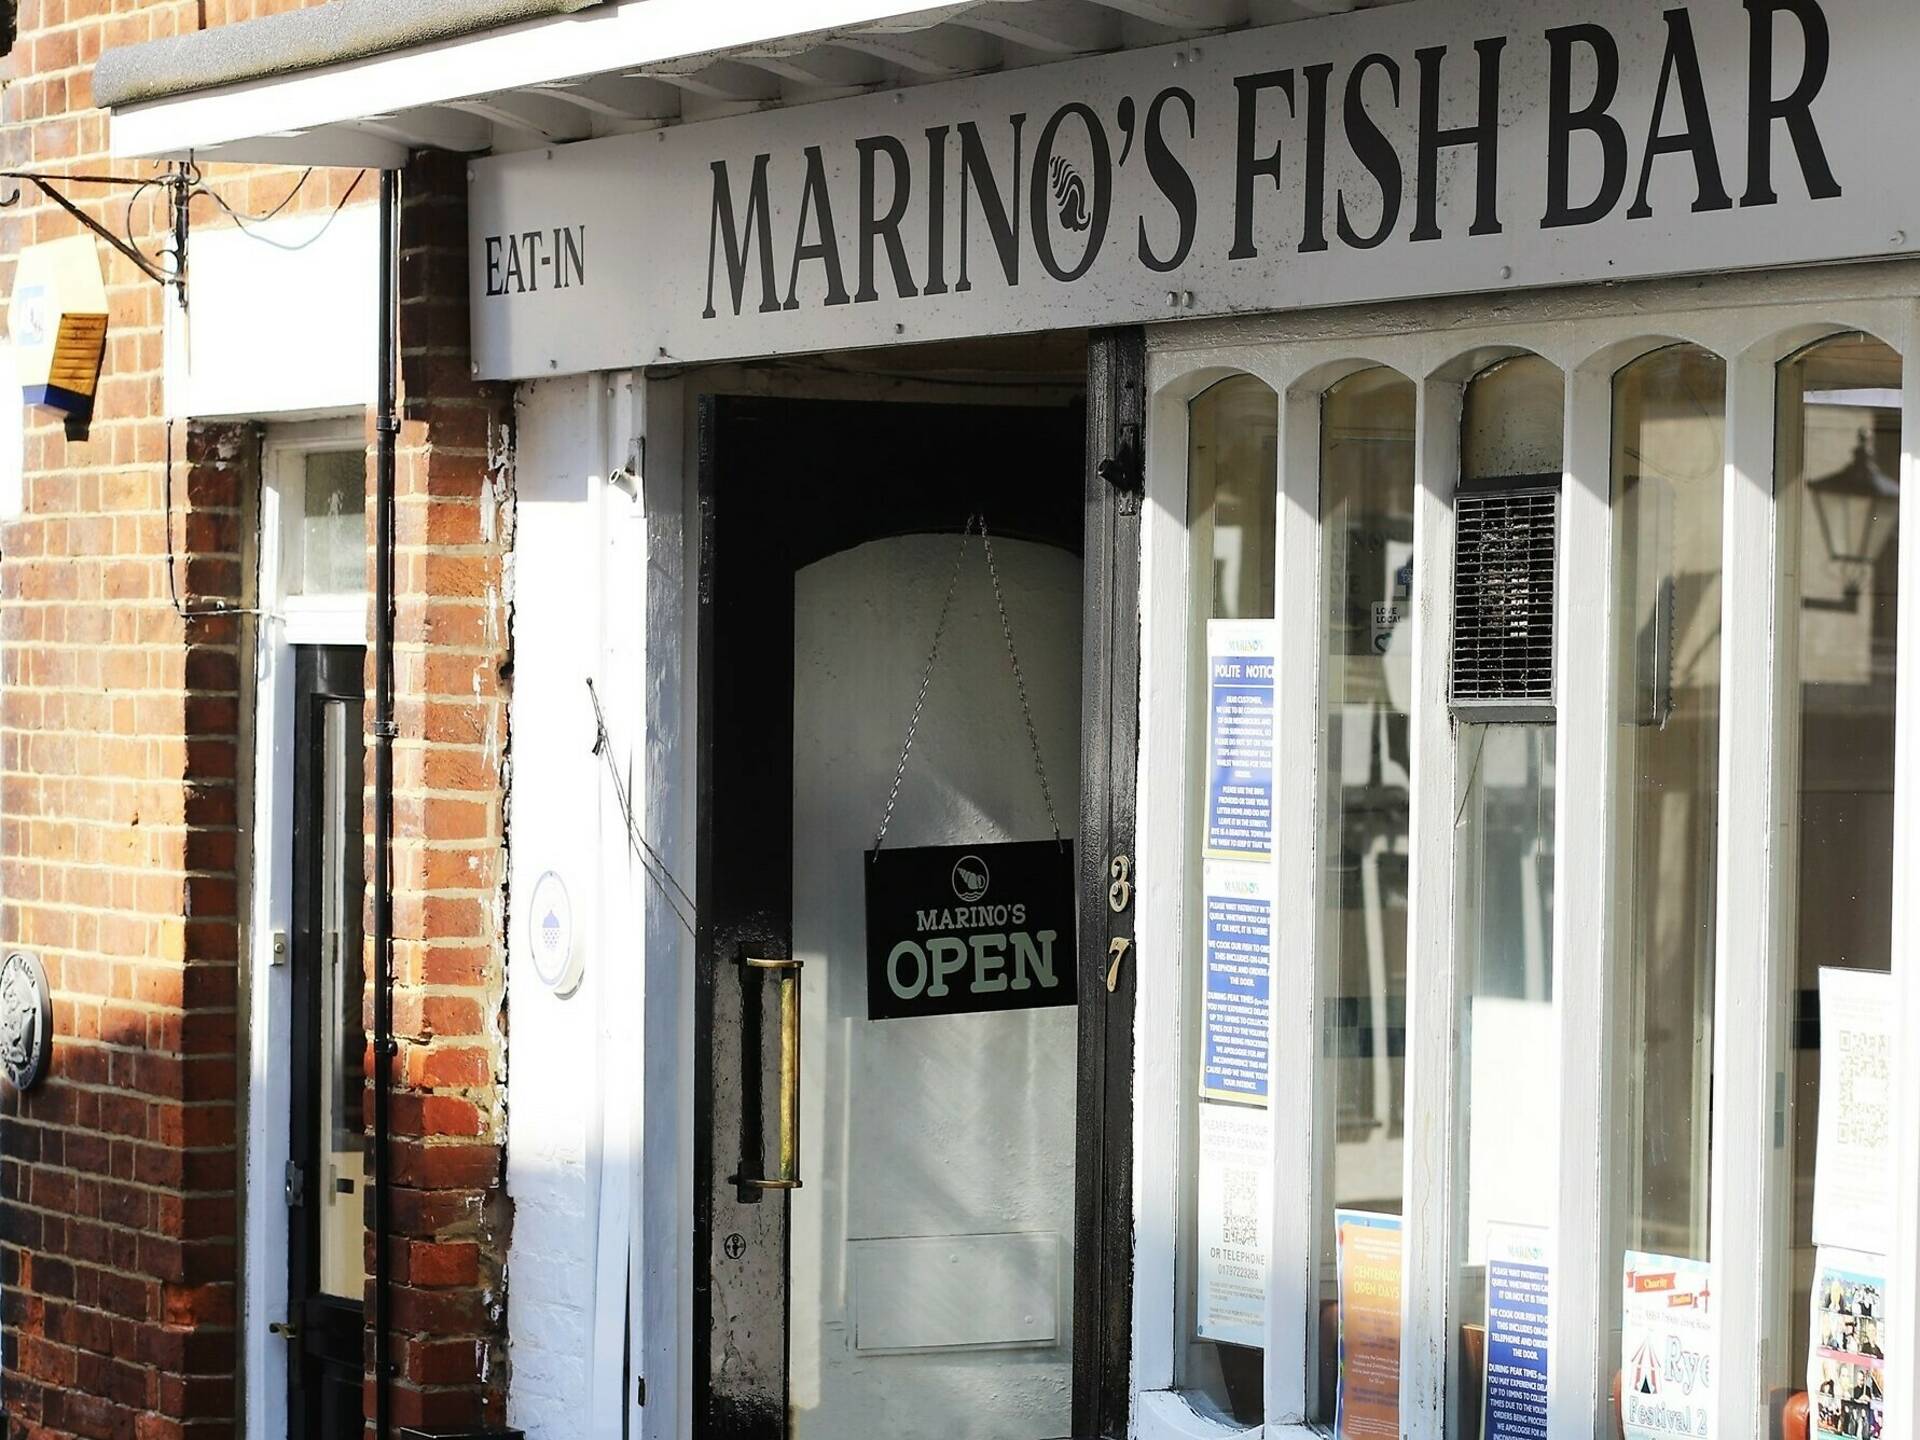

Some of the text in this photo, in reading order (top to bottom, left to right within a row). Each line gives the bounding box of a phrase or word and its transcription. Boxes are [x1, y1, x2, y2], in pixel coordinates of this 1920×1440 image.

[702, 0, 1842, 319] MARINO'S FISH BAR
[484, 225, 585, 297] EAT-IN
[1215, 664, 1274, 678] POLITE NOTIC
[1109, 855, 1131, 913] 3
[917, 904, 1026, 931] MARINO'S
[887, 930, 1058, 1000] OPEN
[1107, 937, 1131, 992] 7
[1210, 1247, 1264, 1266] OR TELEPHONE
[1664, 1334, 1710, 1396] Rye
[1532, 1405, 1547, 1414] VOLUM
[1630, 1396, 1691, 1433] Festival
